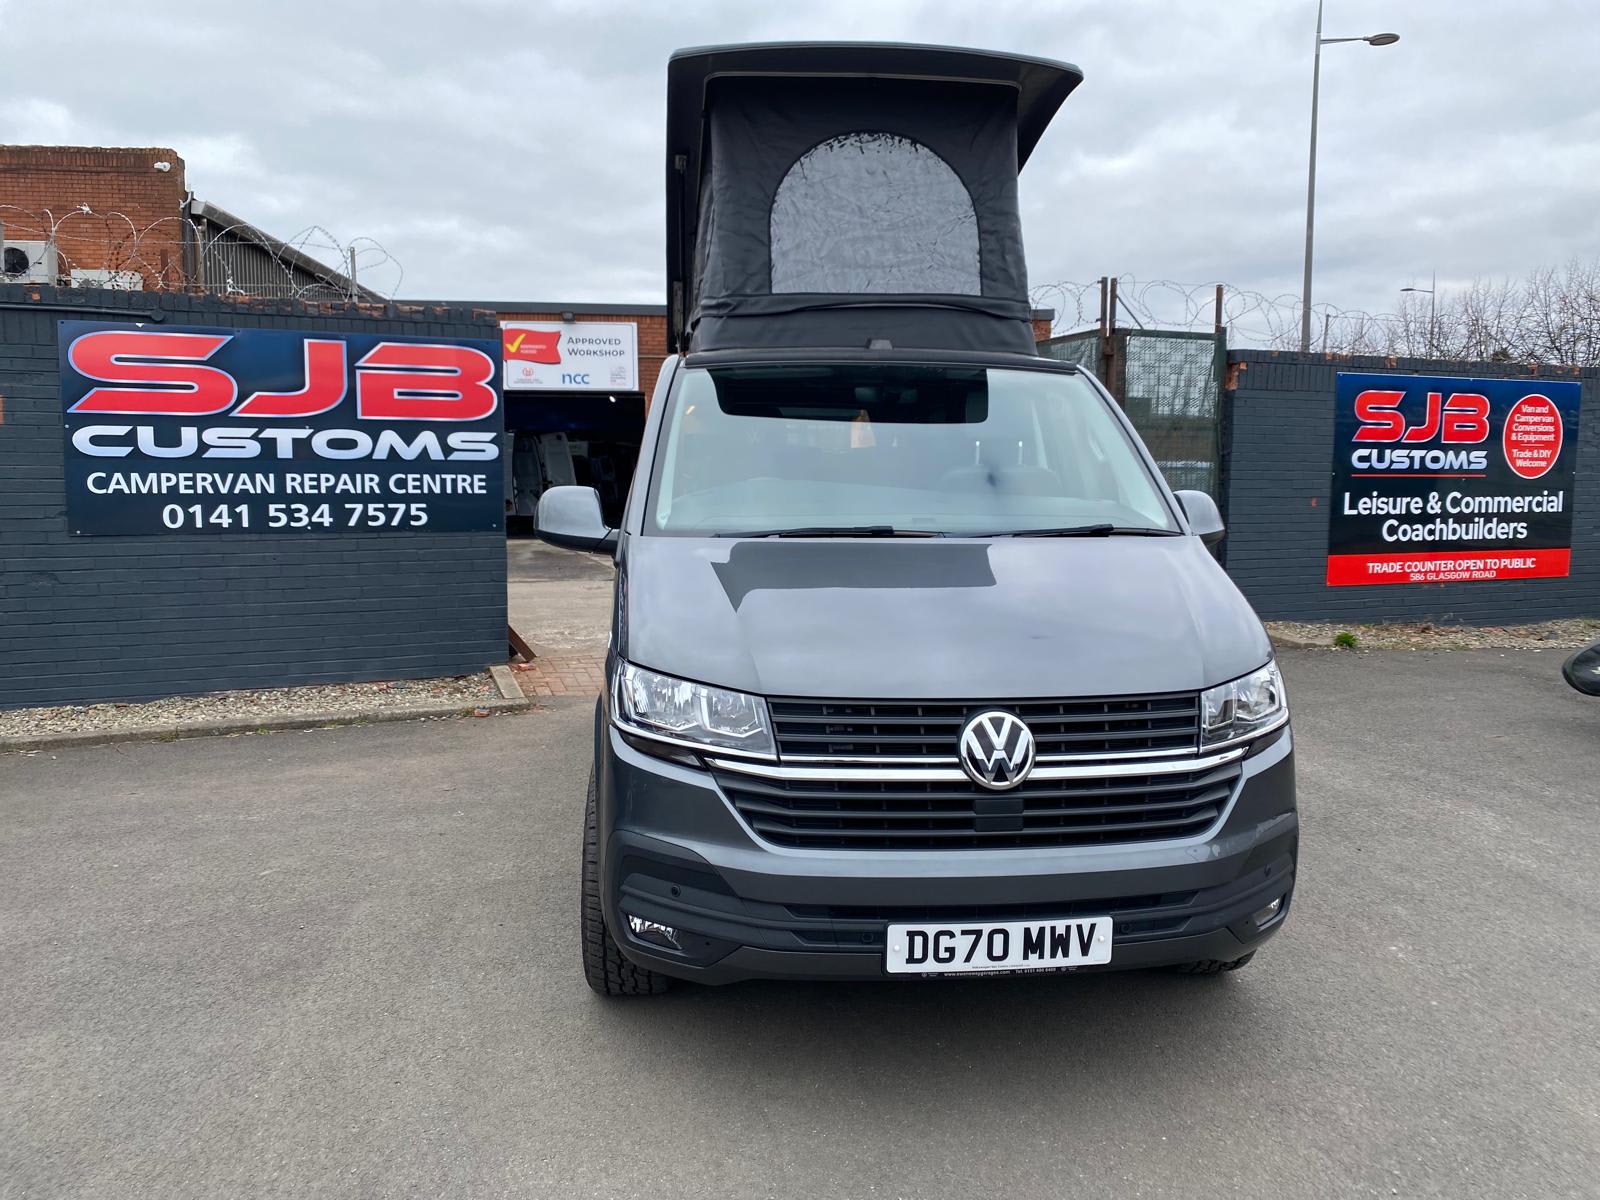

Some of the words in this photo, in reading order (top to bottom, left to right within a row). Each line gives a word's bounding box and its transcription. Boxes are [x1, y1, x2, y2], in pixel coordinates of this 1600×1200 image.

[567, 337, 621, 345] APPROVED
[567, 348, 625, 357] WORKSHOP
[67, 330, 498, 421] SJB
[562, 373, 590, 385] ncc
[1522, 405, 1535, 413] Van
[1535, 405, 1549, 413] and
[1351, 389, 1491, 444] SJB
[1515, 414, 1554, 424] Campervan
[1513, 423, 1555, 432] Conversions
[72, 425, 499, 462] CUSTOMS
[1511, 433, 1517, 441] &
[1518, 433, 1555, 443] Equipment
[1351, 449, 1488, 470] CUSTOMS
[1512, 449, 1532, 458] Trade
[1532, 450, 1538, 458] &
[1538, 449, 1552, 458] DIY
[1516, 459, 1547, 467] Welcome
[87, 472, 275, 494] CAMPERVAN
[286, 473, 380, 494] REPAIR
[389, 474, 487, 494] CENTRE
[1343, 491, 1423, 516] Leisure
[1429, 491, 1442, 514] &
[1446, 490, 1564, 514] Commercial
[162, 504, 249, 528] 0141
[268, 503, 334, 527] 534
[344, 503, 428, 527] 7575
[1382, 517, 1528, 542] Coachbuilders
[1367, 562, 1403, 574] TRADE
[1404, 560, 1454, 572] COUNTER
[1455, 559, 1484, 571] OPEN
[1485, 559, 1499, 570] TO
[1500, 558, 1536, 569] PUBLIC
[1410, 573, 1425, 581] 586
[1427, 571, 1469, 580] GLASGOW
[1472, 570, 1496, 579] ROAD
[906, 928, 1010, 964] DG70
[1022, 923, 1097, 961] MWV
